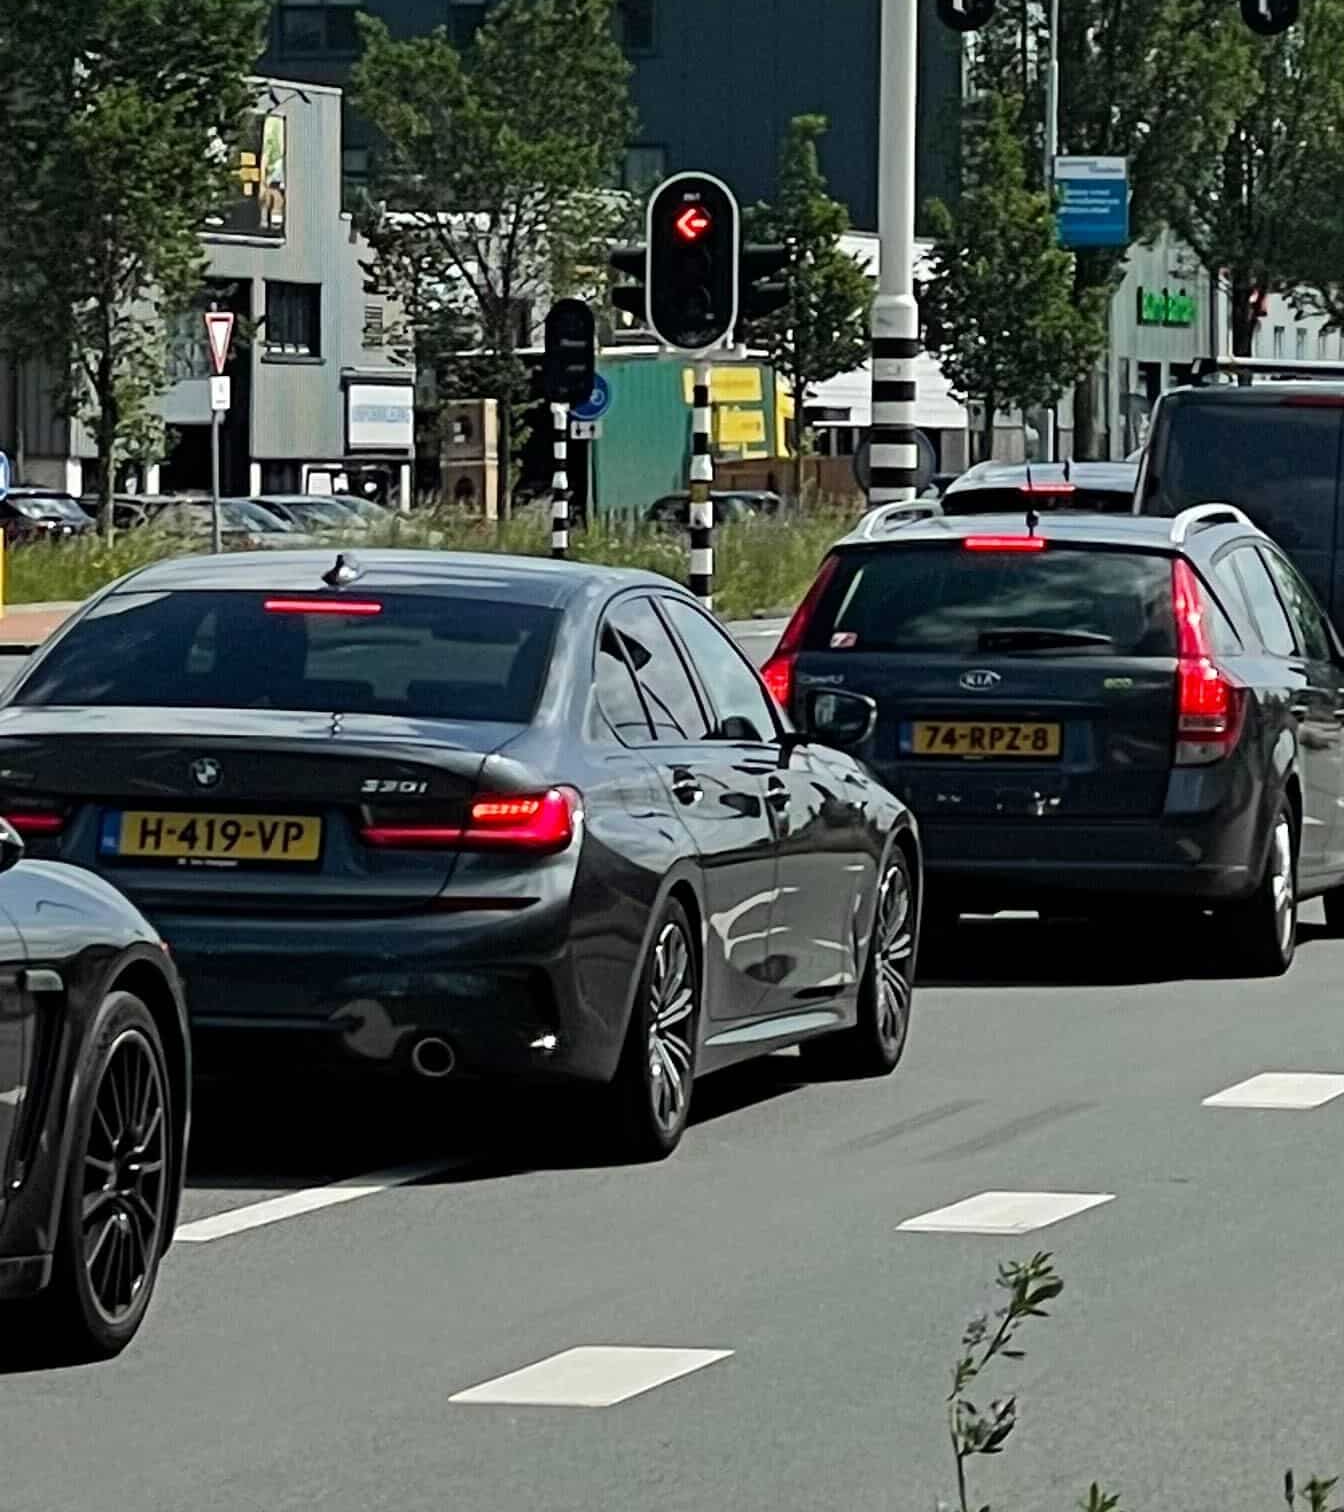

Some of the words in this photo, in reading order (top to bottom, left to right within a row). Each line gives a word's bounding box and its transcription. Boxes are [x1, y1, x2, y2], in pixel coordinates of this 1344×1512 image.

[965, 672, 994, 686] KIA
[925, 725, 1050, 752] 74-RPZ-8
[138, 817, 305, 854] H-419-VP
